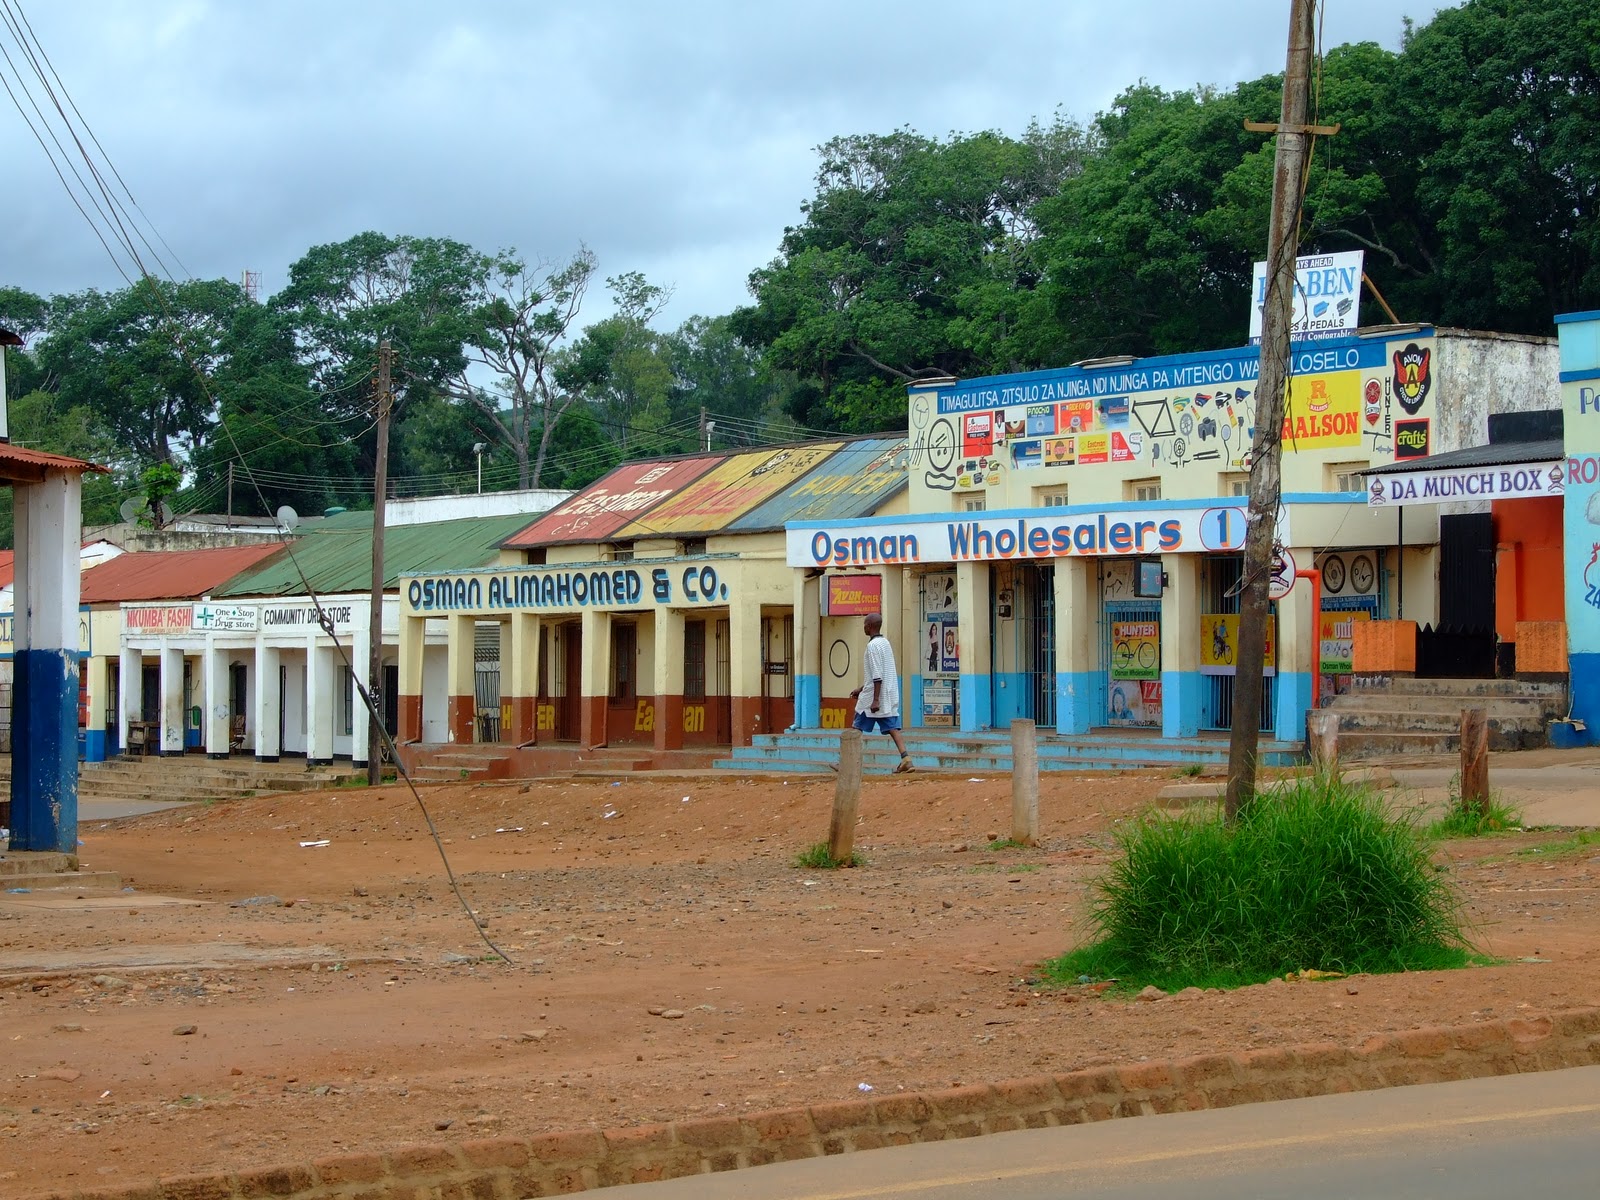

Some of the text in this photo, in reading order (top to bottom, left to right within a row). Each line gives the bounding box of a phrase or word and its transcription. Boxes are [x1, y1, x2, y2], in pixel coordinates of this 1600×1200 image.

[1310, 257, 1333, 268] AHEAD
[1310, 318, 1344, 330] PEDALS
[1403, 353, 1423, 367] AVON
[941, 348, 1359, 412] TIMAGULITSA ZITSULO ZA NJINGA NDI NJINGA PA MTENGO WA LOSELO
[1311, 379, 1327, 399] R
[1384, 376, 1392, 434] HUNTER
[968, 423, 989, 433] Eastman
[1281, 412, 1359, 440] RALSON
[1087, 440, 1106, 449] Eastman
[1397, 430, 1427, 445] crafts
[1391, 469, 1543, 500] DA MUNCH BOX
[1217, 509, 1230, 547] 1
[811, 514, 1183, 567] Osman Wholesalers
[408, 565, 730, 610] OSMAN ALIMAHOMED & CO.
[167, 608, 191, 626] FASHI
[215, 608, 255, 618] One Stop
[264, 608, 306, 625] COMMUNITY
[327, 606, 351, 624] STORE
[215, 617, 234, 628] Drug
[1120, 624, 1156, 637] HUNTER
